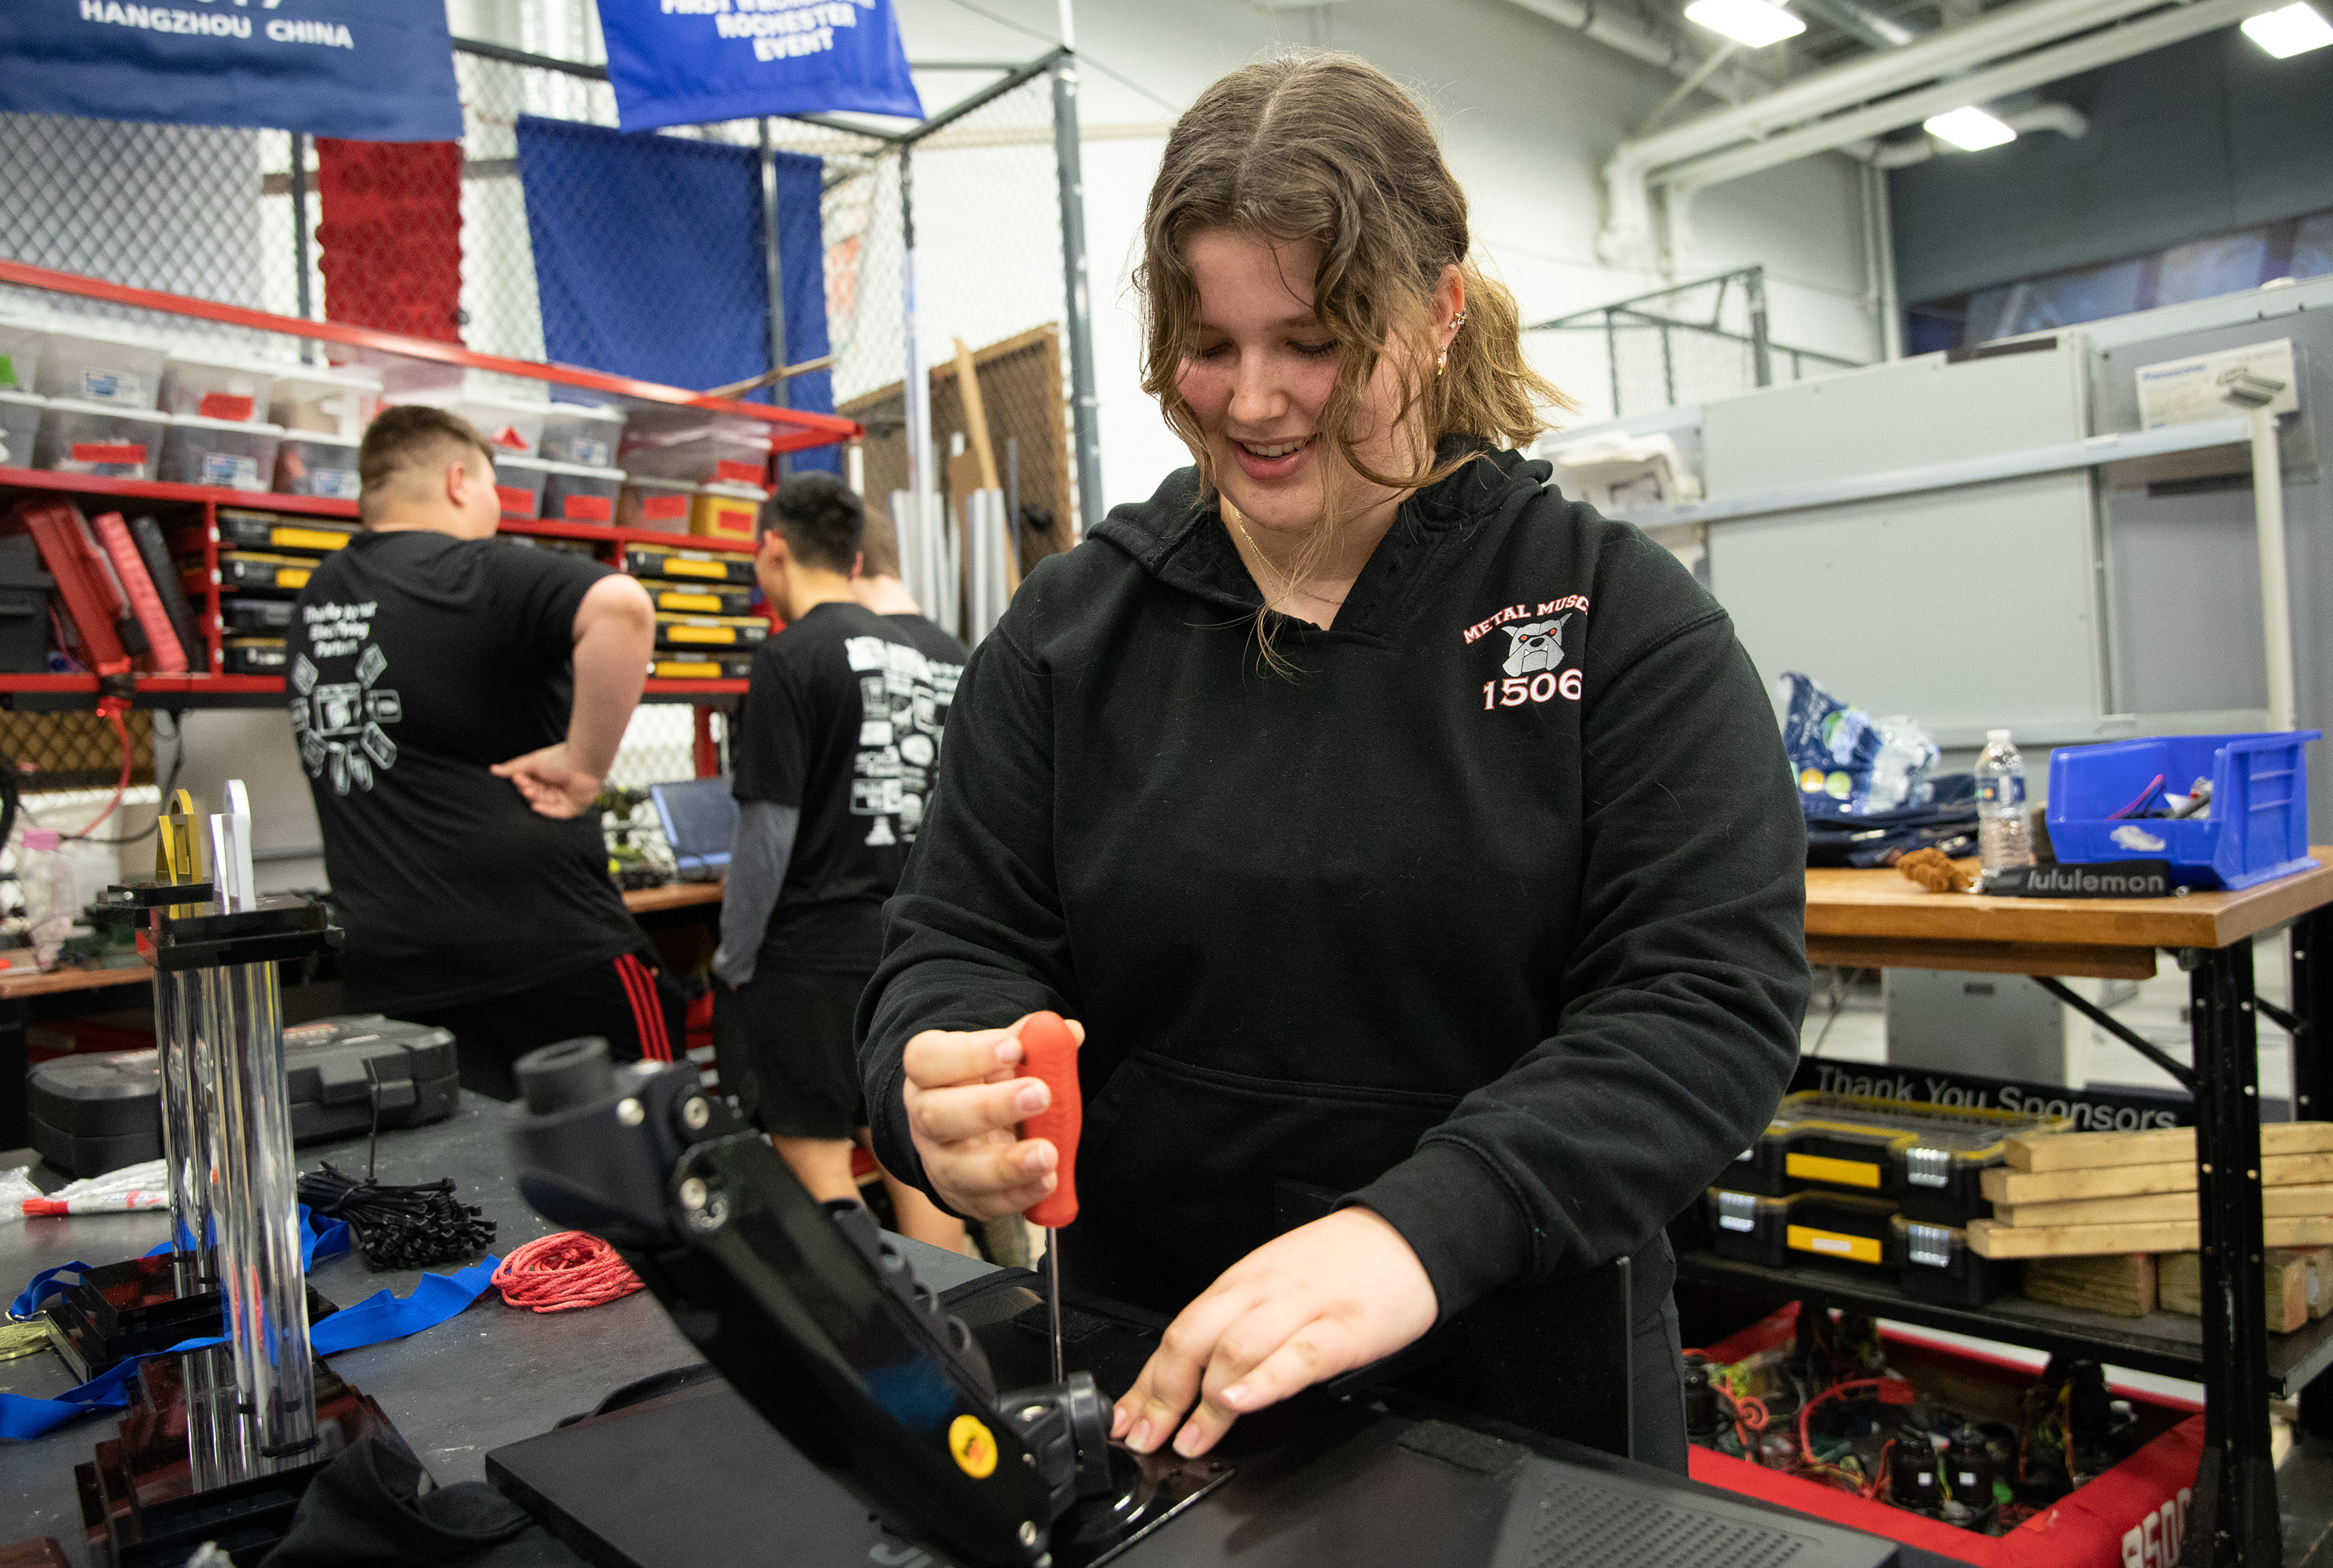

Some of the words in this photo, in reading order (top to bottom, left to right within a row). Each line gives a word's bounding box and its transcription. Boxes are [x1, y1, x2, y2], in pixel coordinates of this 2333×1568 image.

[78, 0, 252, 39] HANGZHOU
[266, 18, 354, 50] CHINA
[714, 2, 857, 39] ROCHESTER
[752, 26, 834, 62] EVENT
[1463, 604, 1532, 645] METAL
[1536, 594, 1589, 617] MUSC
[1482, 667, 1583, 711] 1506
[2026, 868, 2166, 892] lululemon
[1817, 1064, 1914, 1103] Thank
[1925, 1076, 1988, 1112] You
